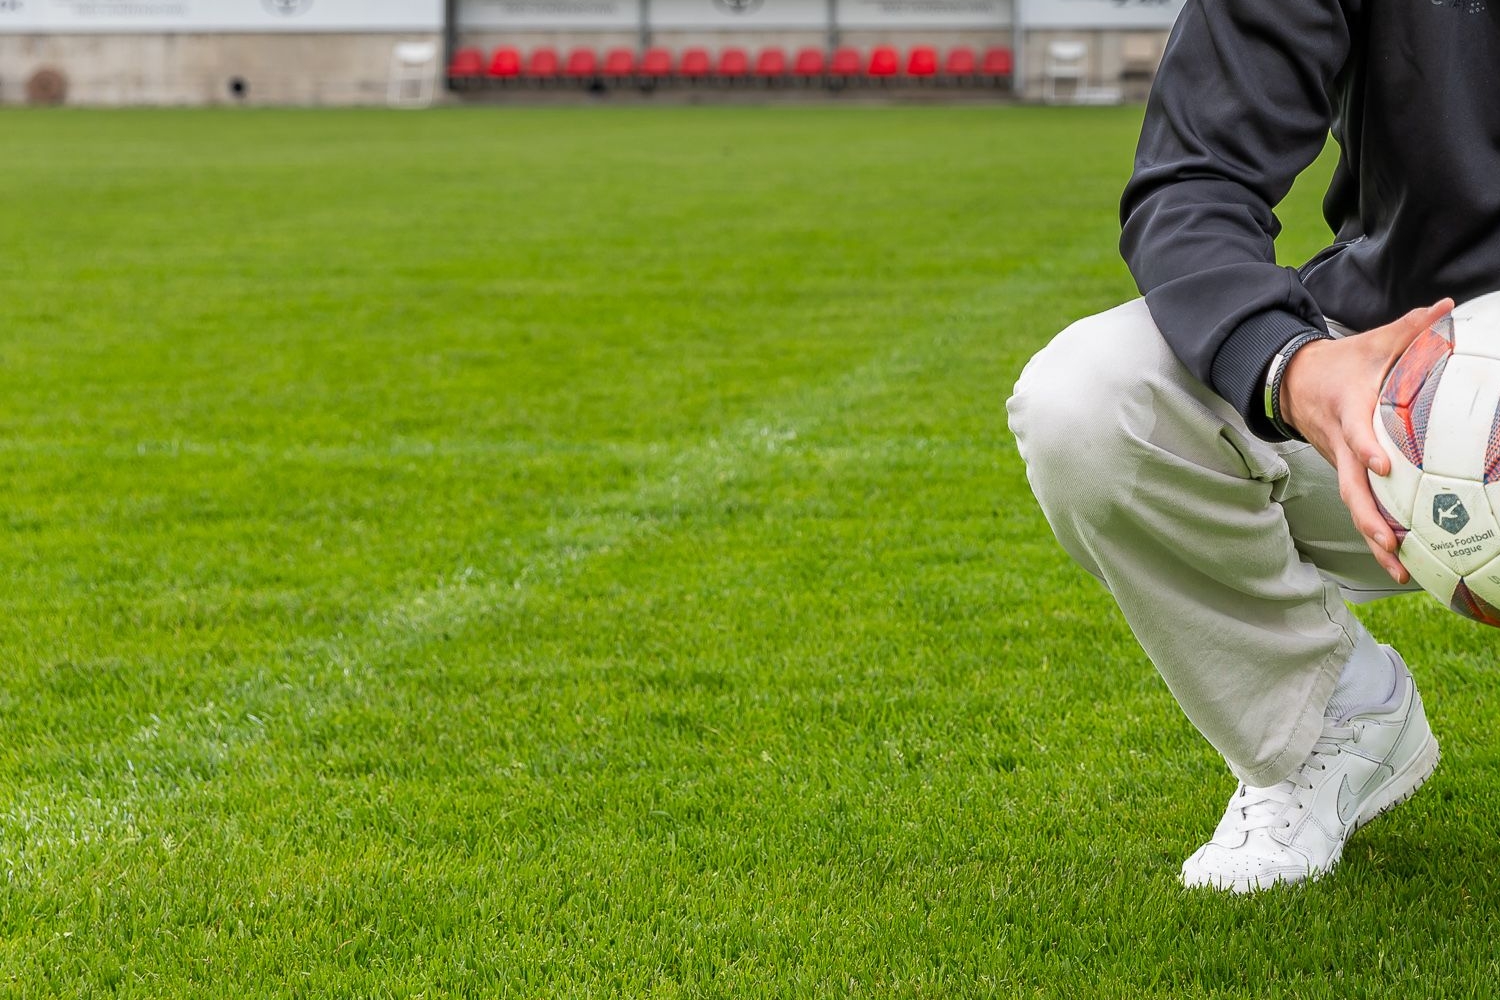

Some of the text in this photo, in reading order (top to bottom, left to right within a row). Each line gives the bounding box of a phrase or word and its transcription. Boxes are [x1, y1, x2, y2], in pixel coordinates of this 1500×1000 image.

[1430, 529, 1495, 551] Swiss Football
[1447, 544, 1483, 558] League
